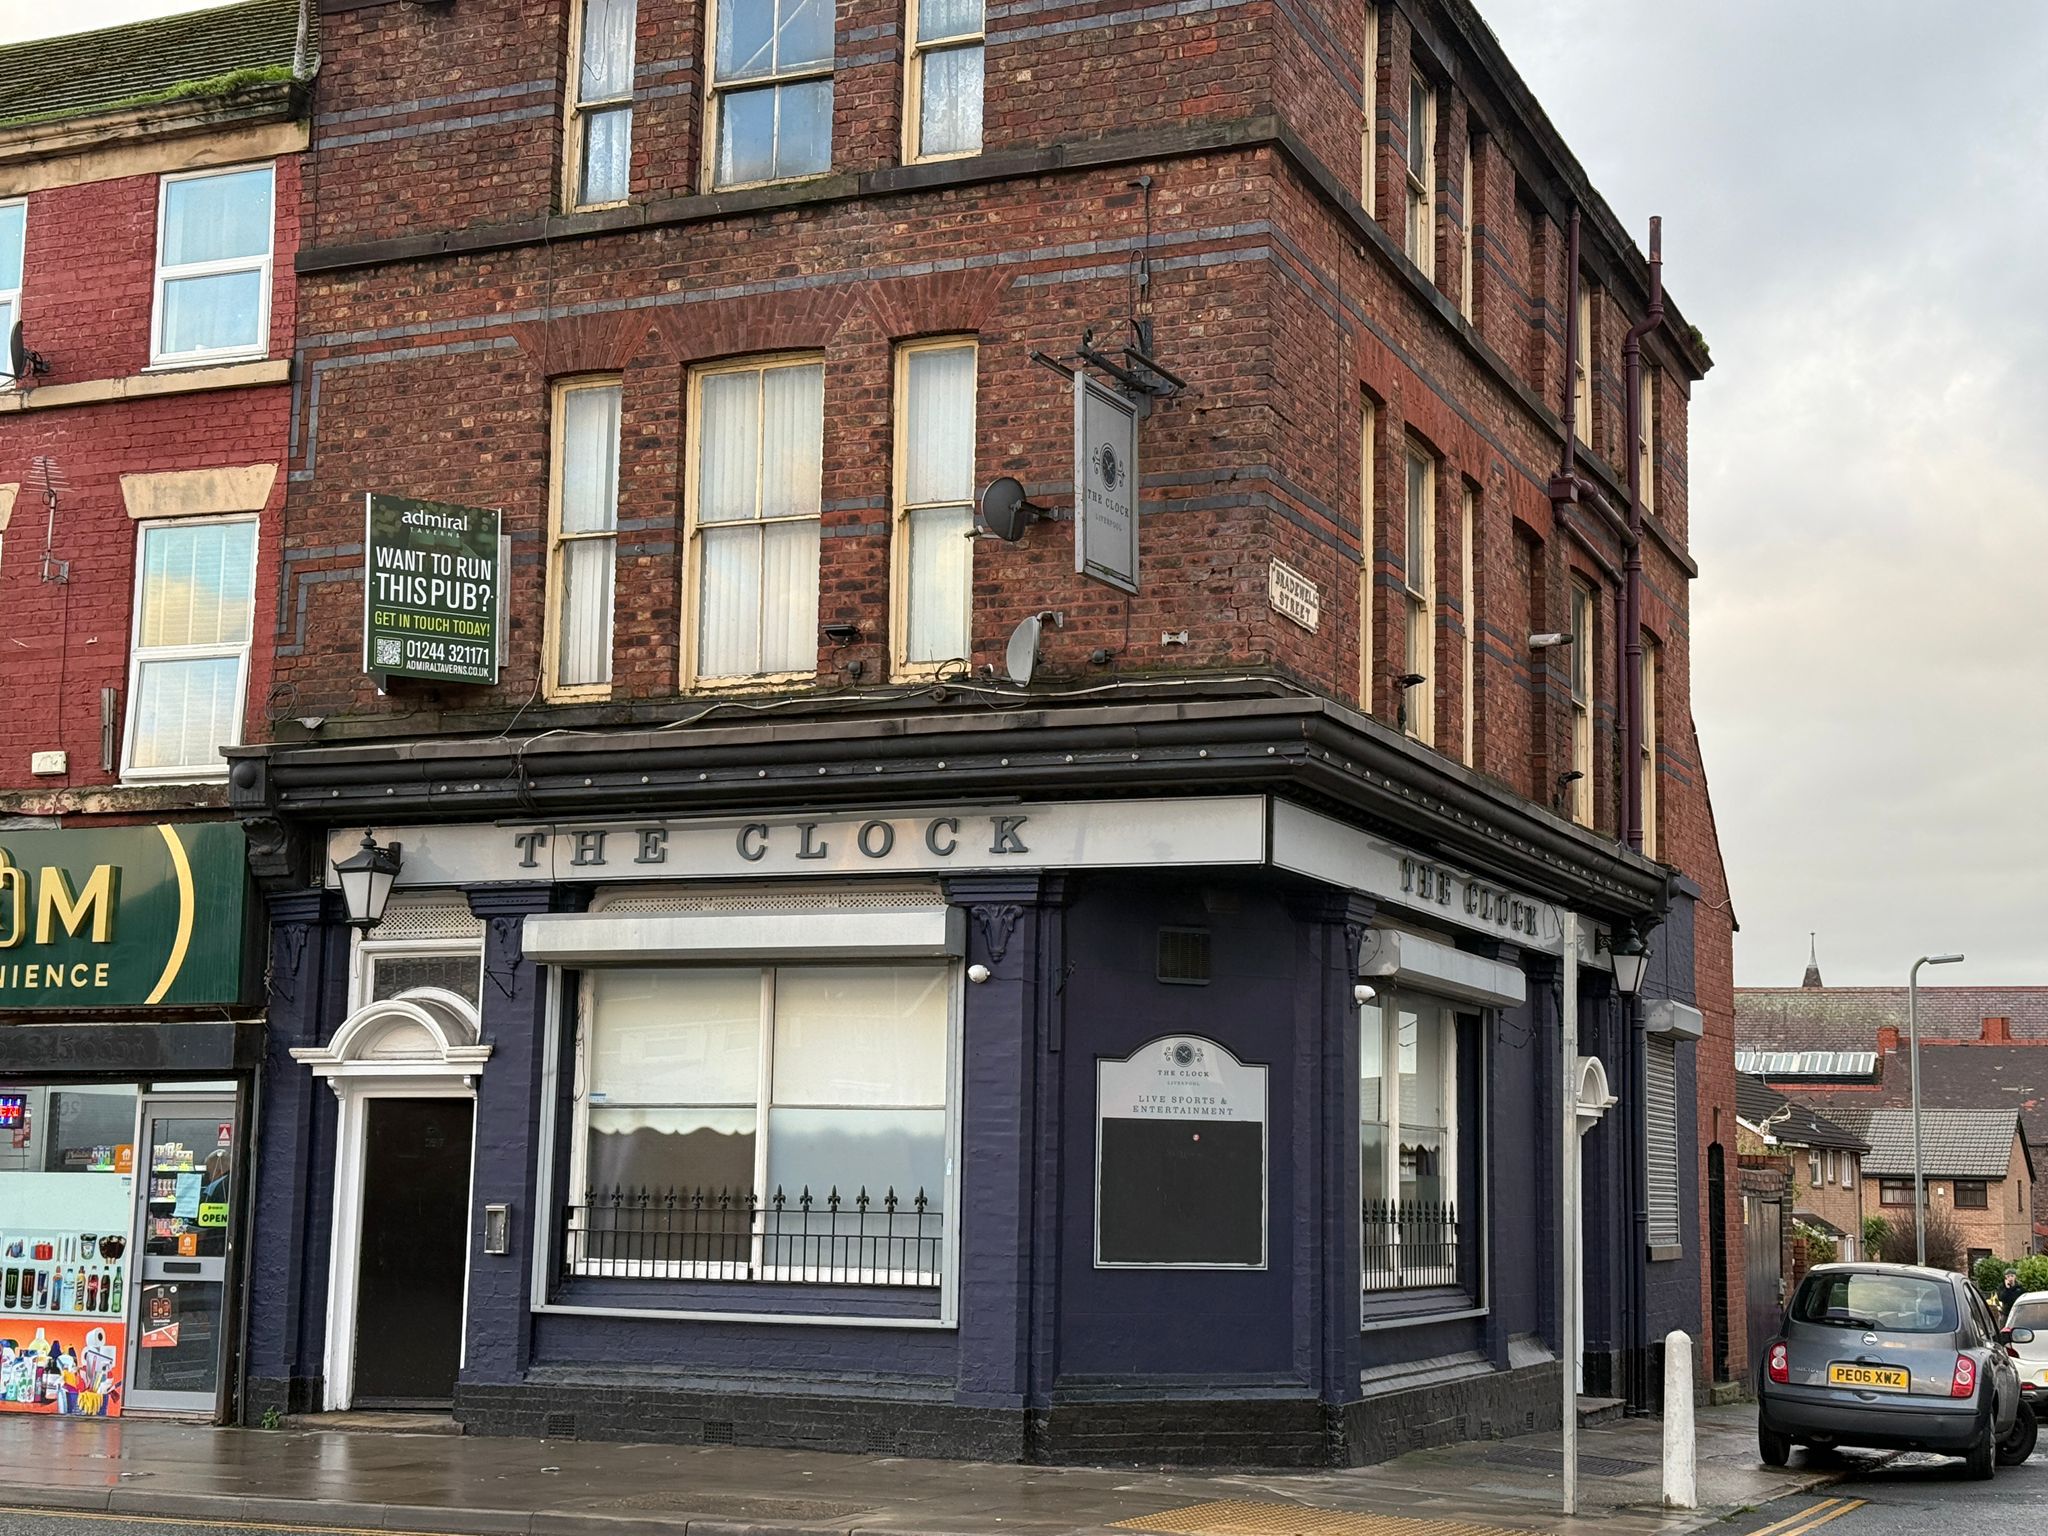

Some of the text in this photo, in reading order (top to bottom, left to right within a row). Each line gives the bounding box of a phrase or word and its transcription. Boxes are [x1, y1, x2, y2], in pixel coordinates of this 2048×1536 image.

[1088, 489, 1129, 518] THE CLOCK
[401, 509, 468, 531] admiral
[410, 527, 461, 538] TAVERNS
[376, 546, 491, 581] WANT TO RUN
[376, 572, 491, 612] THIS PUB?
[1279, 590, 1310, 622] STREET
[374, 610, 490, 637] GET IN TOUCH TODAY!
[406, 640, 489, 666] 01244 321171
[406, 660, 489, 677] ADMIRALTAVERNS.CO.UK
[515, 815, 1029, 868] THE CLOCK
[1400, 856, 1539, 937] THE CLOCK
[1133, 1105, 1234, 1115] ENTERTAINMENT
[1138, 1095, 1166, 1103] LIVE
[1171, 1096, 1215, 1104] SPORTS
[202, 1214, 228, 1222] OPEN
[1836, 1368, 1871, 1383] PE06
[1875, 1371, 1902, 1385] XWZ
